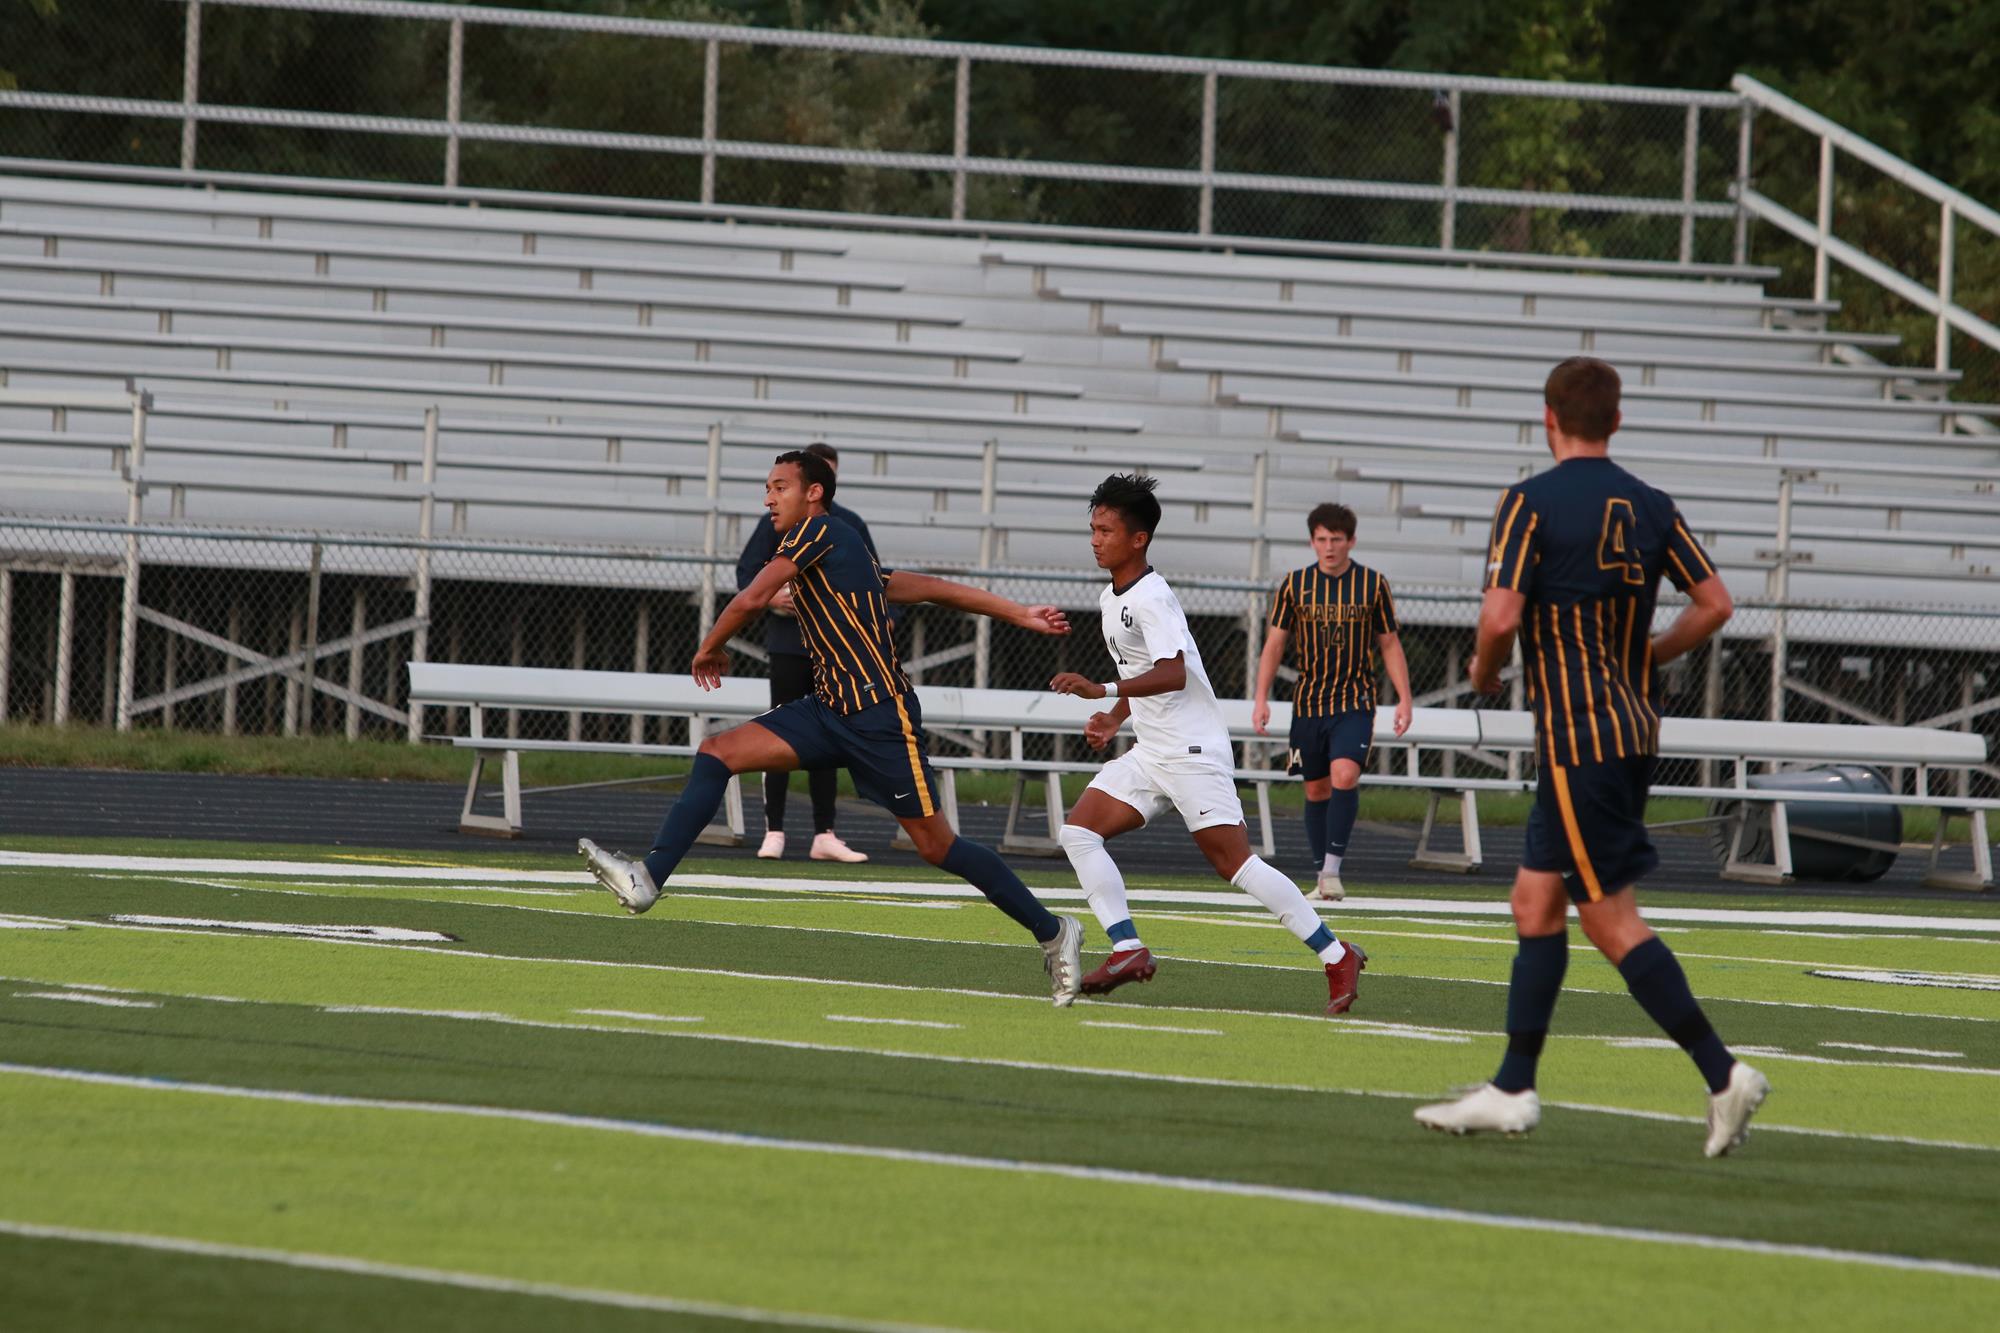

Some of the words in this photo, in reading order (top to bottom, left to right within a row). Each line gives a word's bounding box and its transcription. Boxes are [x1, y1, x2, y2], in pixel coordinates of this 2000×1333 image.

[1597, 498, 1645, 585] 4
[1295, 604, 1374, 622] MARIAN
[1320, 624, 1346, 650] 14
